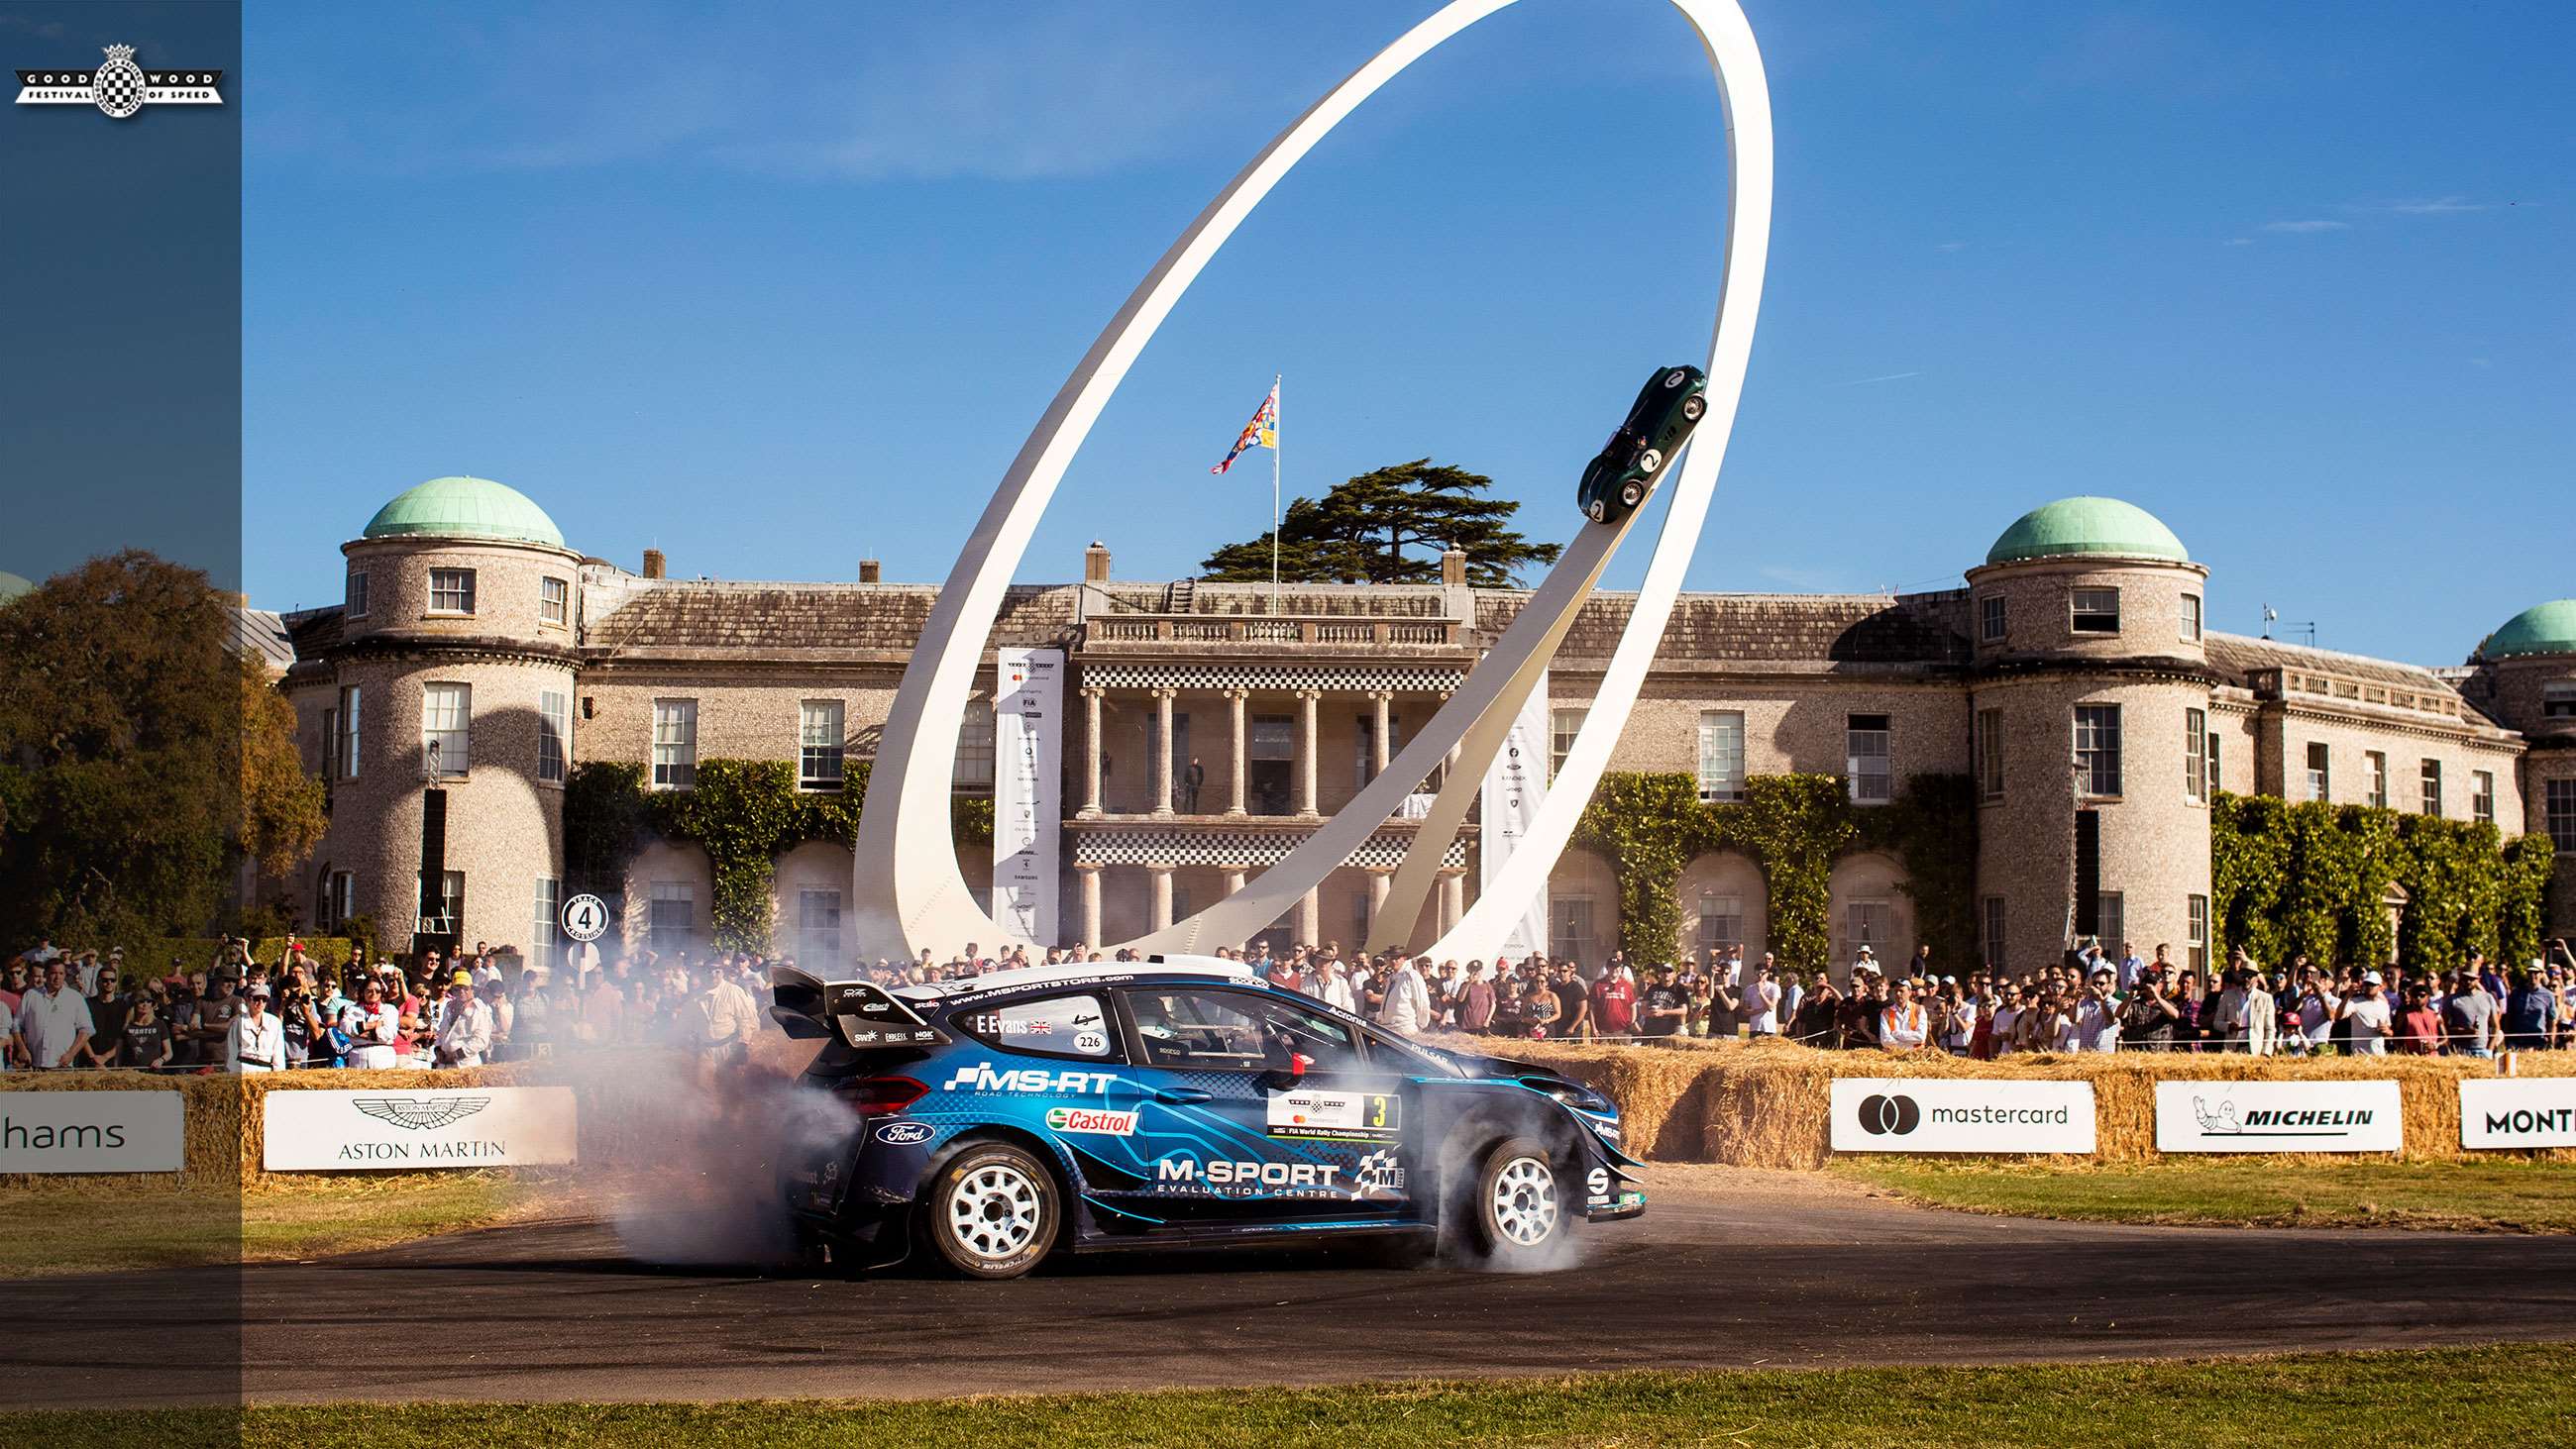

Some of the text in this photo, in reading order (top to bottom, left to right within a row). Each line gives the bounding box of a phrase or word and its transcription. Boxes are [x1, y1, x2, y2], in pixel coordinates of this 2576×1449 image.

[1644, 454, 1659, 467] 2
[578, 906, 591, 929] 4
[950, 975, 1134, 1006] www.MSPORTSTORE.com
[977, 1015, 1027, 1034] E Evans
[1080, 1037, 1100, 1047] 226
[1411, 1044, 1449, 1065] PULSAR
[976, 1069, 1117, 1093] MS-RT
[1068, 1111, 1131, 1132] Castrol
[1373, 1096, 1386, 1127] 3
[1932, 1104, 2068, 1123] mastercard
[2245, 1109, 2373, 1125] MICHELIN
[2486, 1109, 2576, 1133] MONT
[4, 1116, 125, 1149] hams
[888, 1125, 924, 1141] Ford
[339, 1141, 506, 1159] ASTON MARTIN
[1158, 1159, 1340, 1187] M-SPORT
[1378, 1170, 1396, 1186] M
[1157, 1185, 1338, 1198] EVALUATION CENTRE
